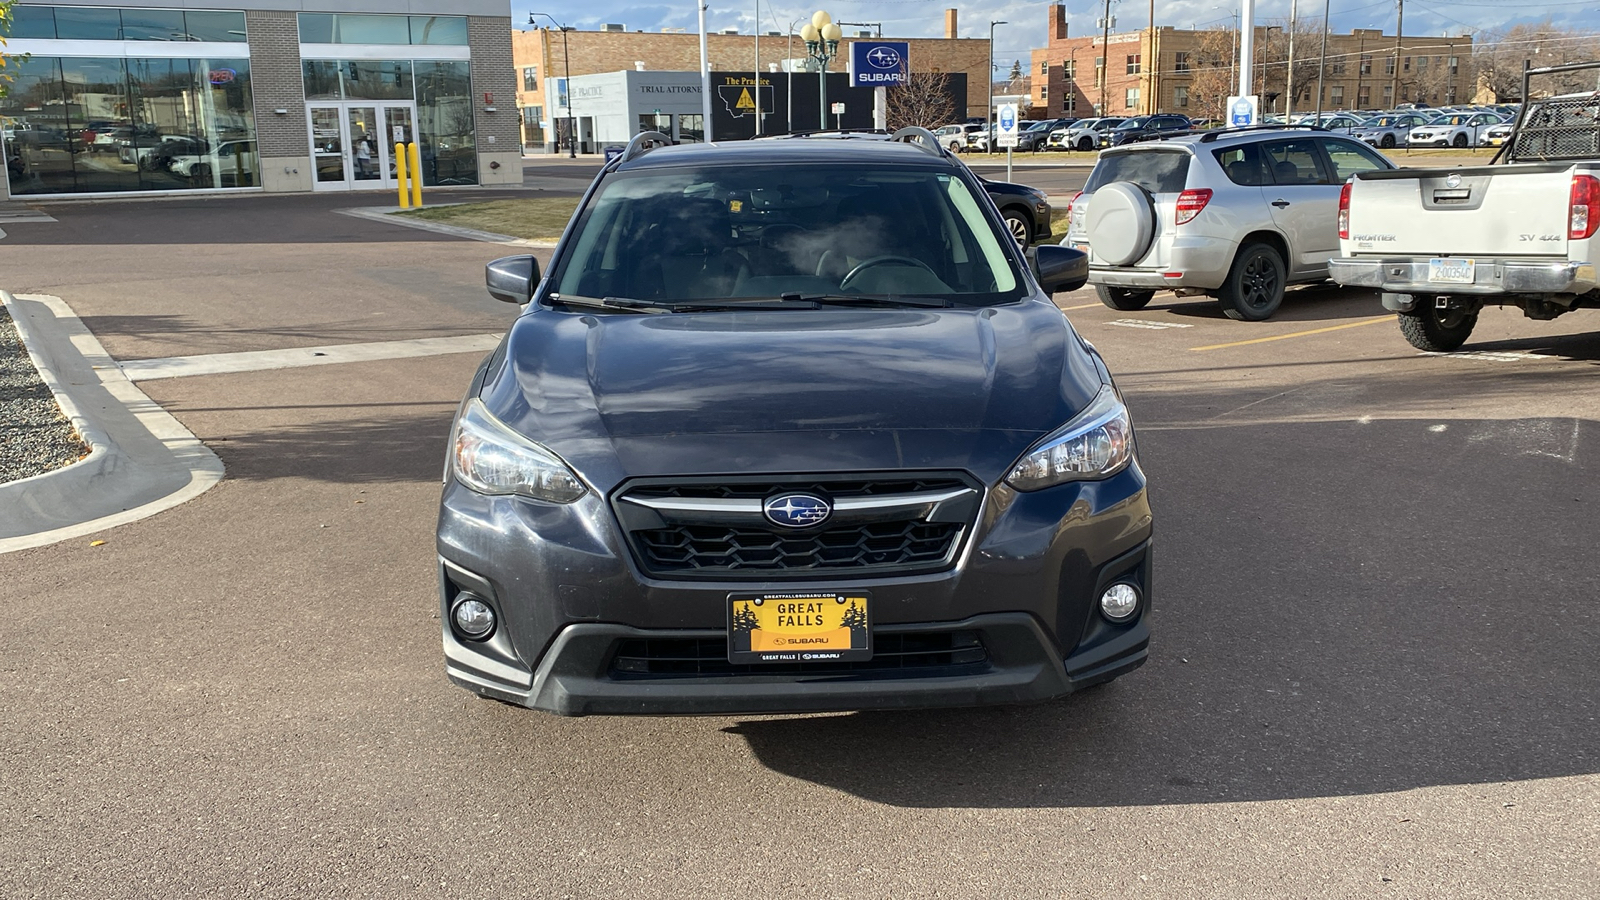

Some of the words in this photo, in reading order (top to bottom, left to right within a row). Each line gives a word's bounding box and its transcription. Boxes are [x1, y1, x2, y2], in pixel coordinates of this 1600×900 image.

[208, 71, 233, 81] OPEN
[859, 73, 906, 82] SUBARU
[725, 77, 740, 85] The
[741, 77, 770, 86] Pracice
[1353, 234, 1396, 242] FRONTIER
[1519, 234, 1535, 242] SV
[778, 603, 823, 613] GREAT
[778, 615, 823, 626] FALLS
